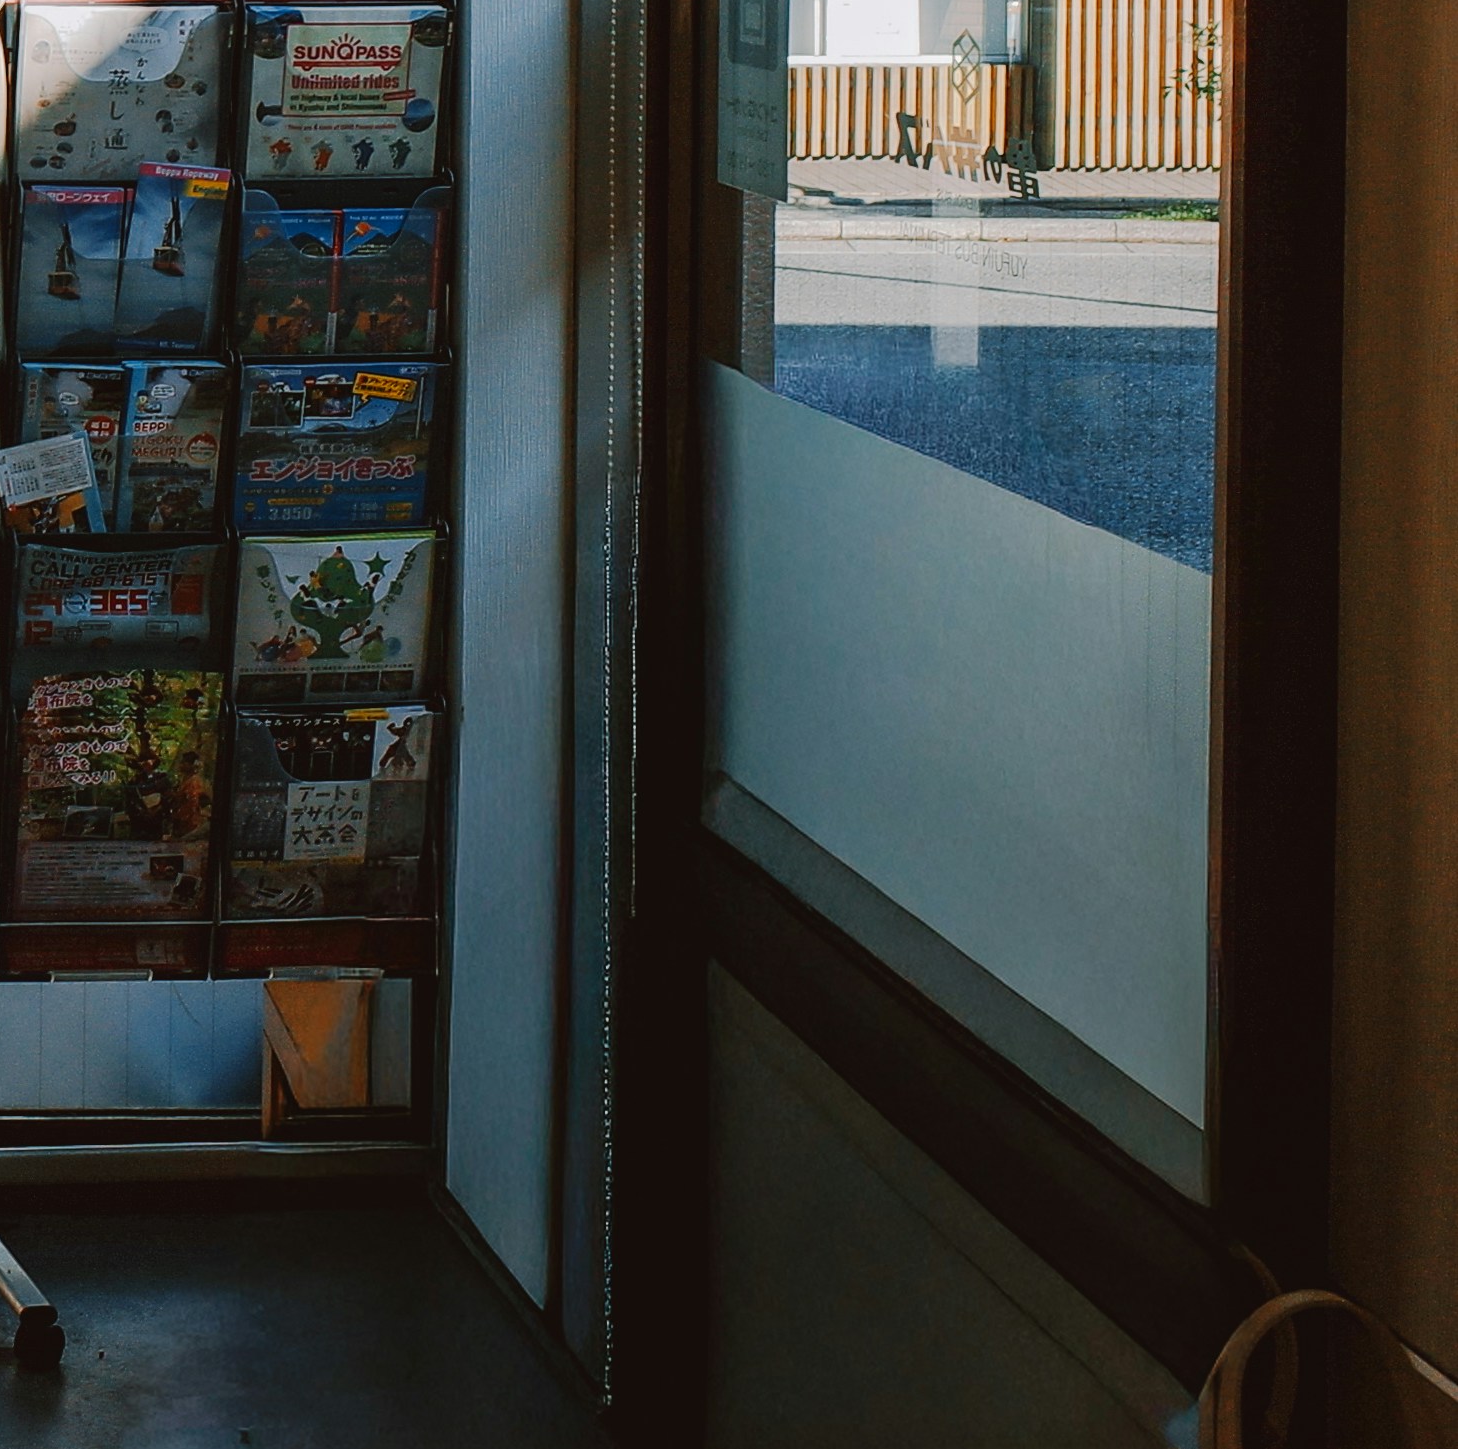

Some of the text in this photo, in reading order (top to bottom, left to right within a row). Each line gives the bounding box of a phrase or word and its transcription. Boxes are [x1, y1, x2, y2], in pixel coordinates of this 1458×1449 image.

[294, 44, 402, 60] SUNQ PASS
[291, 75, 400, 90] Unlimited rides
[250, 454, 416, 482] エンジョイきっぷ
[31, 560, 173, 577] CALL CENTER
[90, 589, 149, 615] 365
[292, 823, 358, 846] 大茶会
